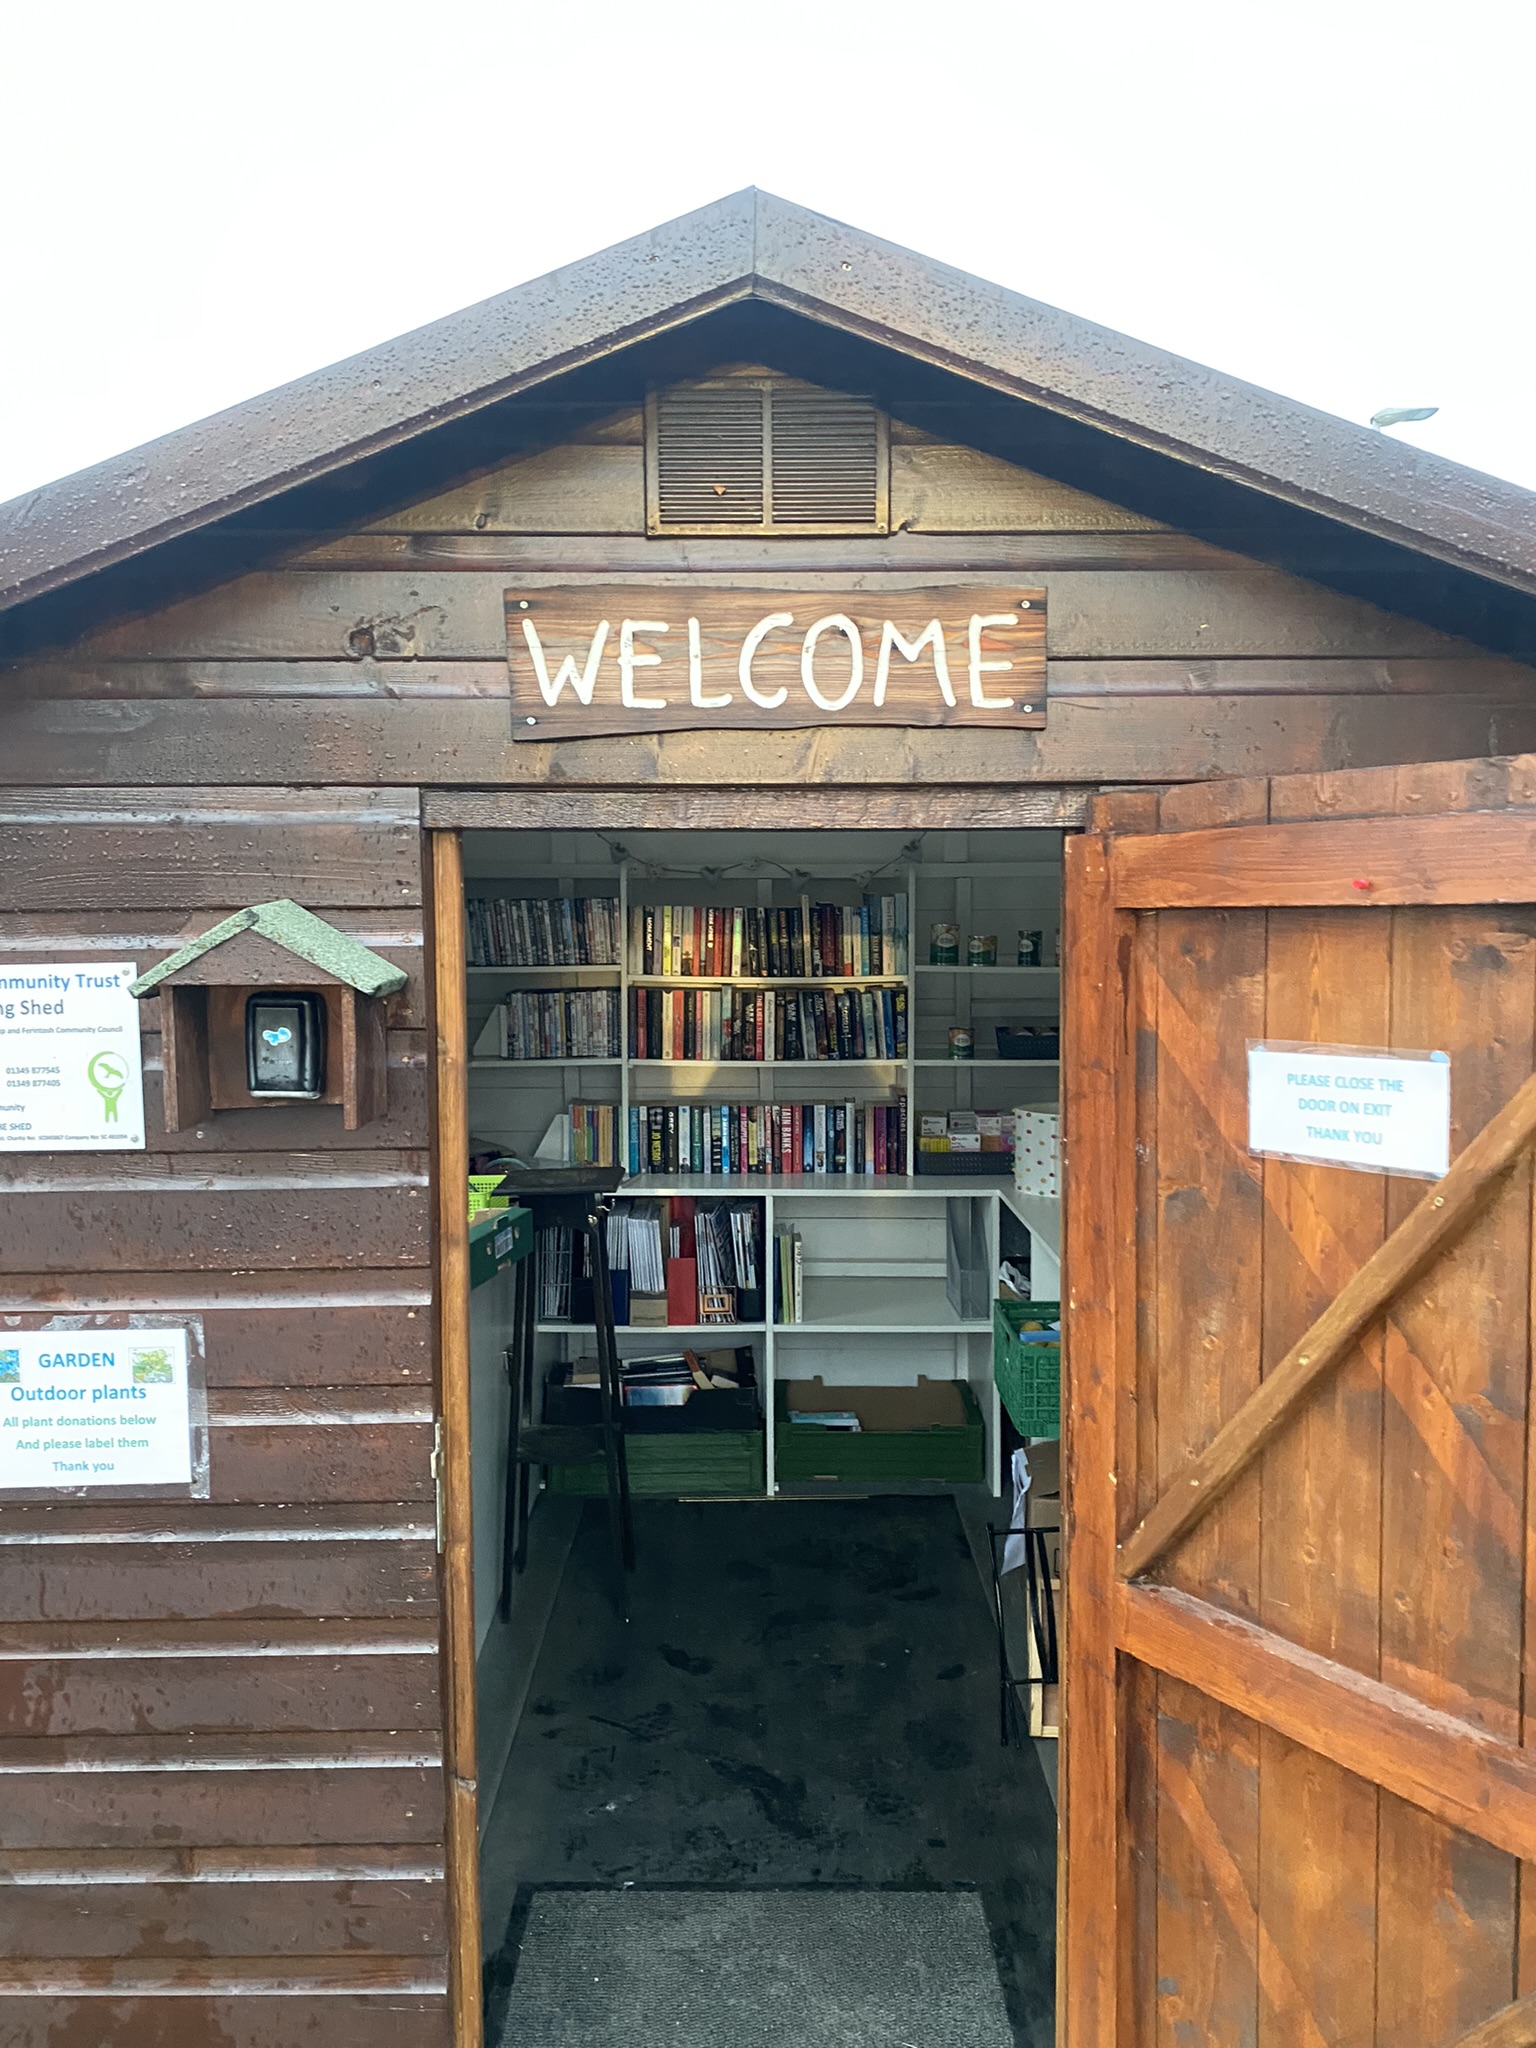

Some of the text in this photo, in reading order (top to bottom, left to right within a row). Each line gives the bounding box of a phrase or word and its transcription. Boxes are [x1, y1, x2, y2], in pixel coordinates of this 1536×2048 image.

[522, 612, 1019, 711] WELCOME
[75, 974, 121, 988] Trust
[20, 999, 64, 1015] Shed
[7, 1027, 21, 1035] and
[56, 1025, 96, 1035] Community
[97, 1025, 123, 1034] Council
[1286, 1073, 1405, 1092] PLEASE CLOSE THE
[898, 1096, 907, 1132] apaches
[1298, 1098, 1392, 1117] DOOR ON EXIT
[9, 1122, 32, 1131] SHED
[781, 1108, 792, 1154] IAIN BANKS
[651, 1131, 662, 1140] JO
[1306, 1126, 1383, 1145] THANK YOU
[38, 1352, 115, 1368] GARDEN
[10, 1384, 146, 1403] Outdoor plants
[3, 1414, 157, 1429] All plant donations below
[16, 1438, 149, 1451] And please label them
[52, 1461, 115, 1473] Thank you
